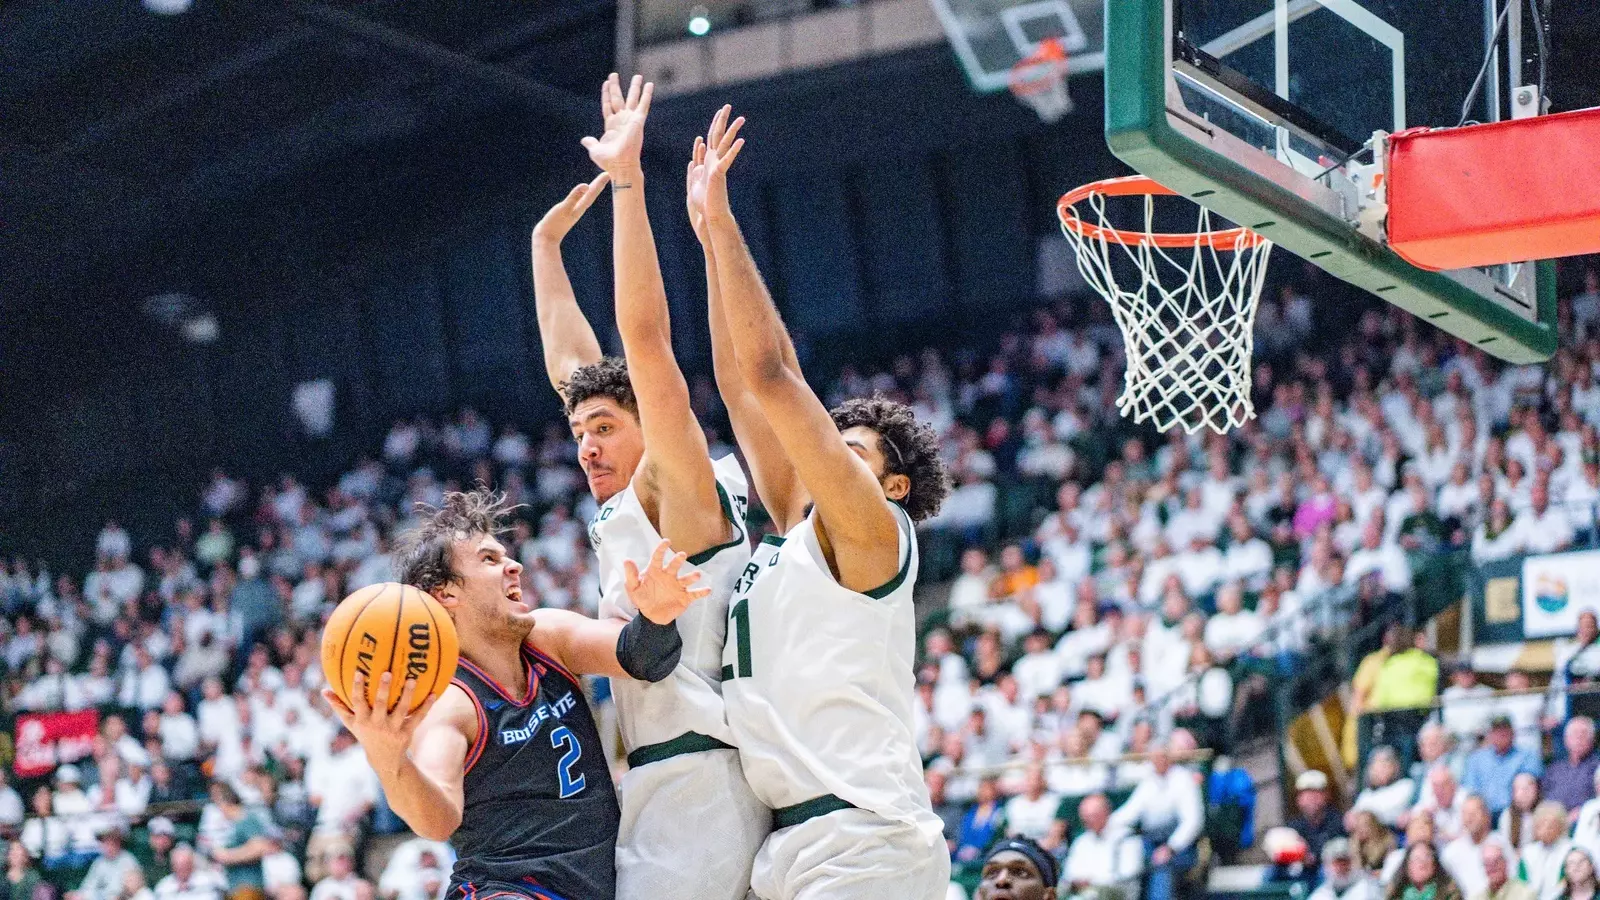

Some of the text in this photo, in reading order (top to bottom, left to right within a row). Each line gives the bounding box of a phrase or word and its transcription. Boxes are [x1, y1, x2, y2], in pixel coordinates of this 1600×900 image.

[721, 598, 752, 682] 1
[501, 705, 549, 744] BOISE
[550, 726, 586, 799] 2
